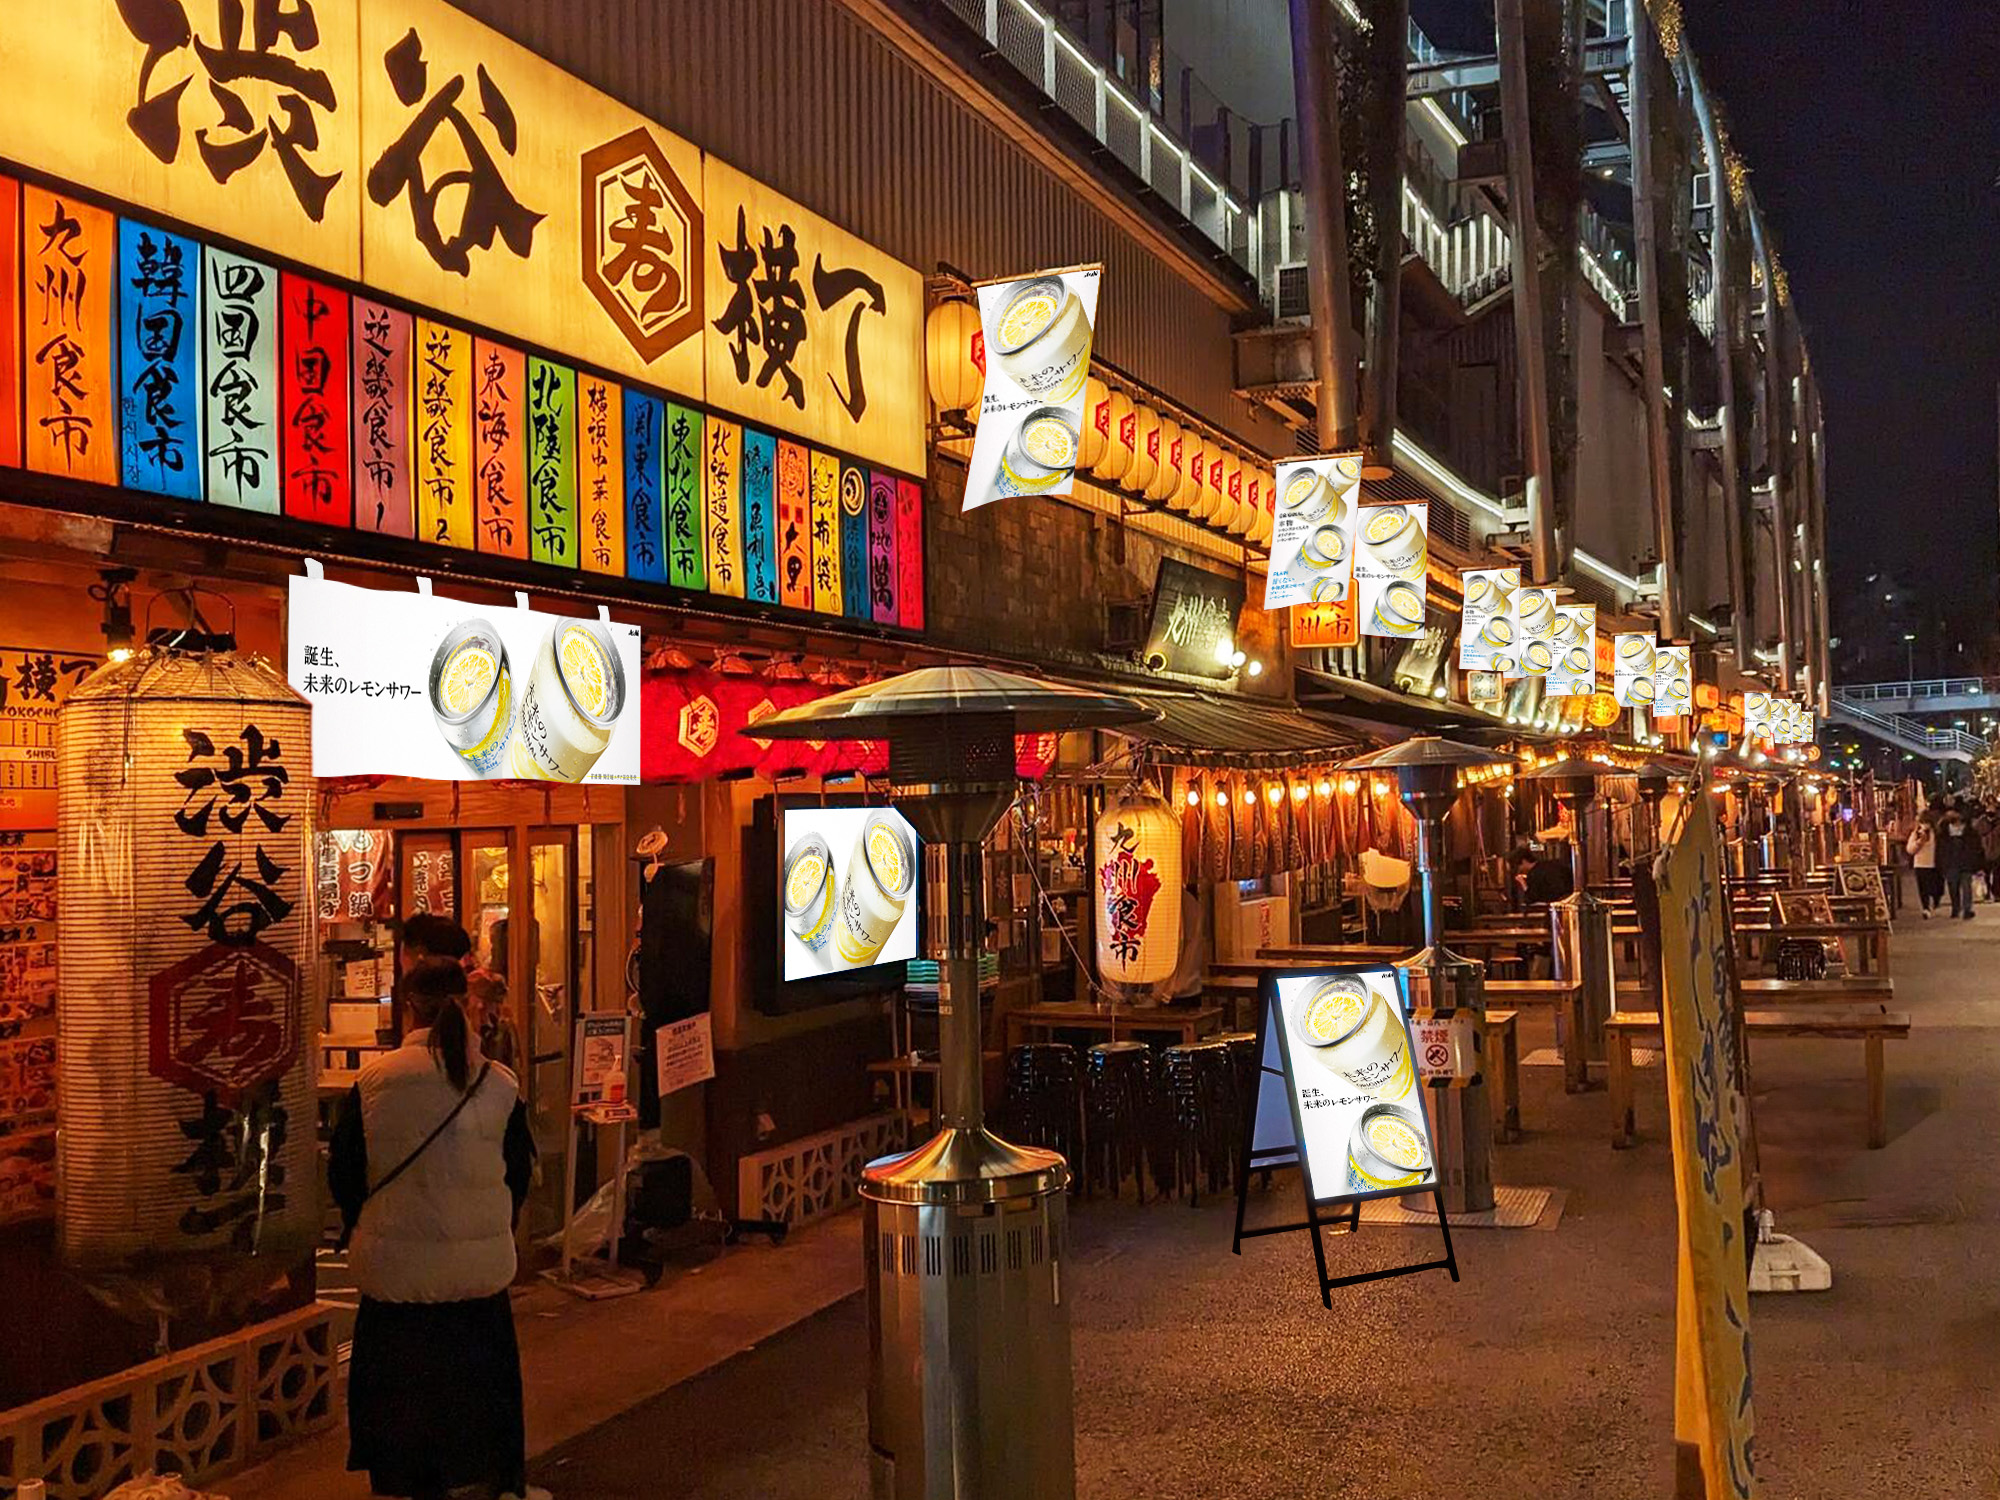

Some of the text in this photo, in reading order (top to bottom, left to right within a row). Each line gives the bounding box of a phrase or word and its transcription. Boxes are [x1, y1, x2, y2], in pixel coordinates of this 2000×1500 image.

[117, 0, 548, 278] 渋谷
[712, 203, 887, 425] 横丁
[36, 200, 92, 472] 九州食市
[131, 232, 188, 491] 韓国食市
[209, 256, 268, 503] 四国食市
[292, 285, 338, 512] 中国食市
[423, 330, 456, 541] 近畿食市2
[480, 348, 514, 549] 東海食市
[532, 364, 567, 562] 北陸食市
[587, 382, 613, 569] 横浜中華食市
[632, 400, 655, 576] 関東食市
[669, 411, 695, 583] 東北食市
[711, 423, 732, 590] 北海道食市
[302, 671, 422, 701] 未来のレモンサワー
[303, 644, 340, 668] 誕生、
[173, 724, 296, 945] 渋谷
[1109, 821, 1142, 973] 九州食市
[1303, 1095, 1378, 1110] 未来のレモンサワー
[1420, 1029, 1449, 1044] 禁煙
